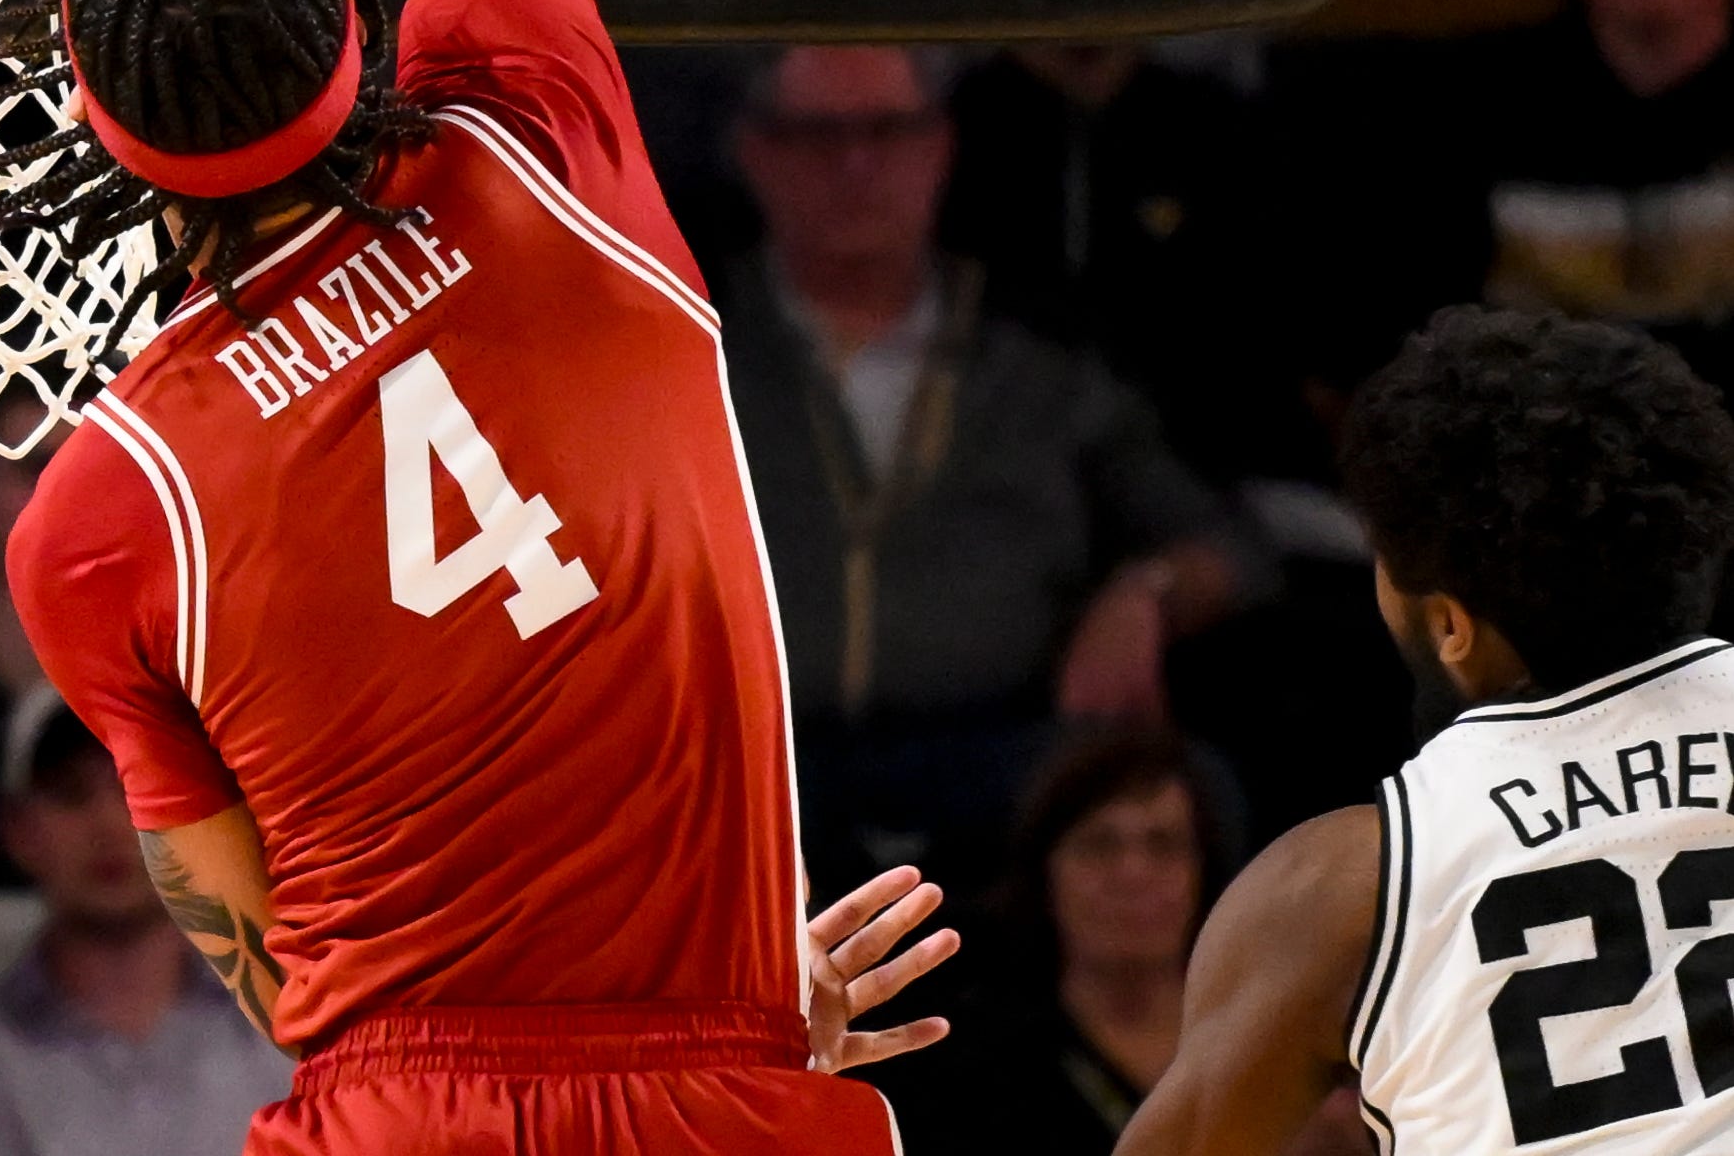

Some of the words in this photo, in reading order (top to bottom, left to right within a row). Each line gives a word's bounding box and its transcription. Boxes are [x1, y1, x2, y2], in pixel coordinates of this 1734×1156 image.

[215, 205, 473, 420] BRAZILE
[378, 348, 600, 641] 4
[1489, 731, 1734, 848] CARE
